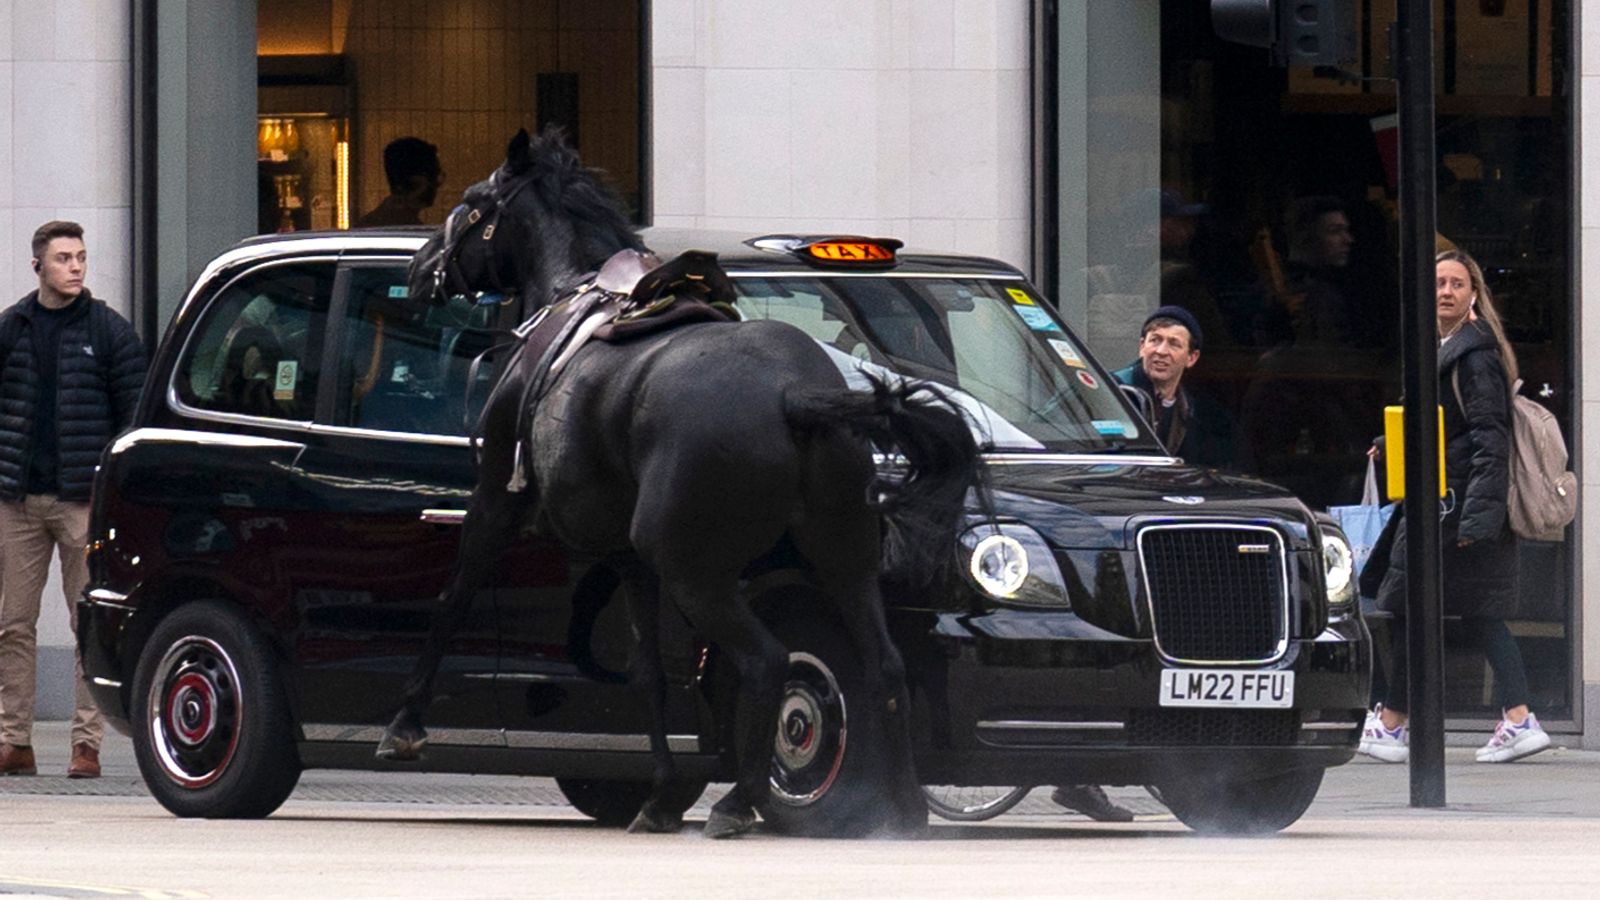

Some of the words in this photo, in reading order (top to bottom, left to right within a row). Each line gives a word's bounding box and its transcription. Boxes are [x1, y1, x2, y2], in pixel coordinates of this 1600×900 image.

[816, 245, 888, 258] TAXI
[1171, 672, 1234, 700] LM22
[1241, 674, 1285, 701] FFU
